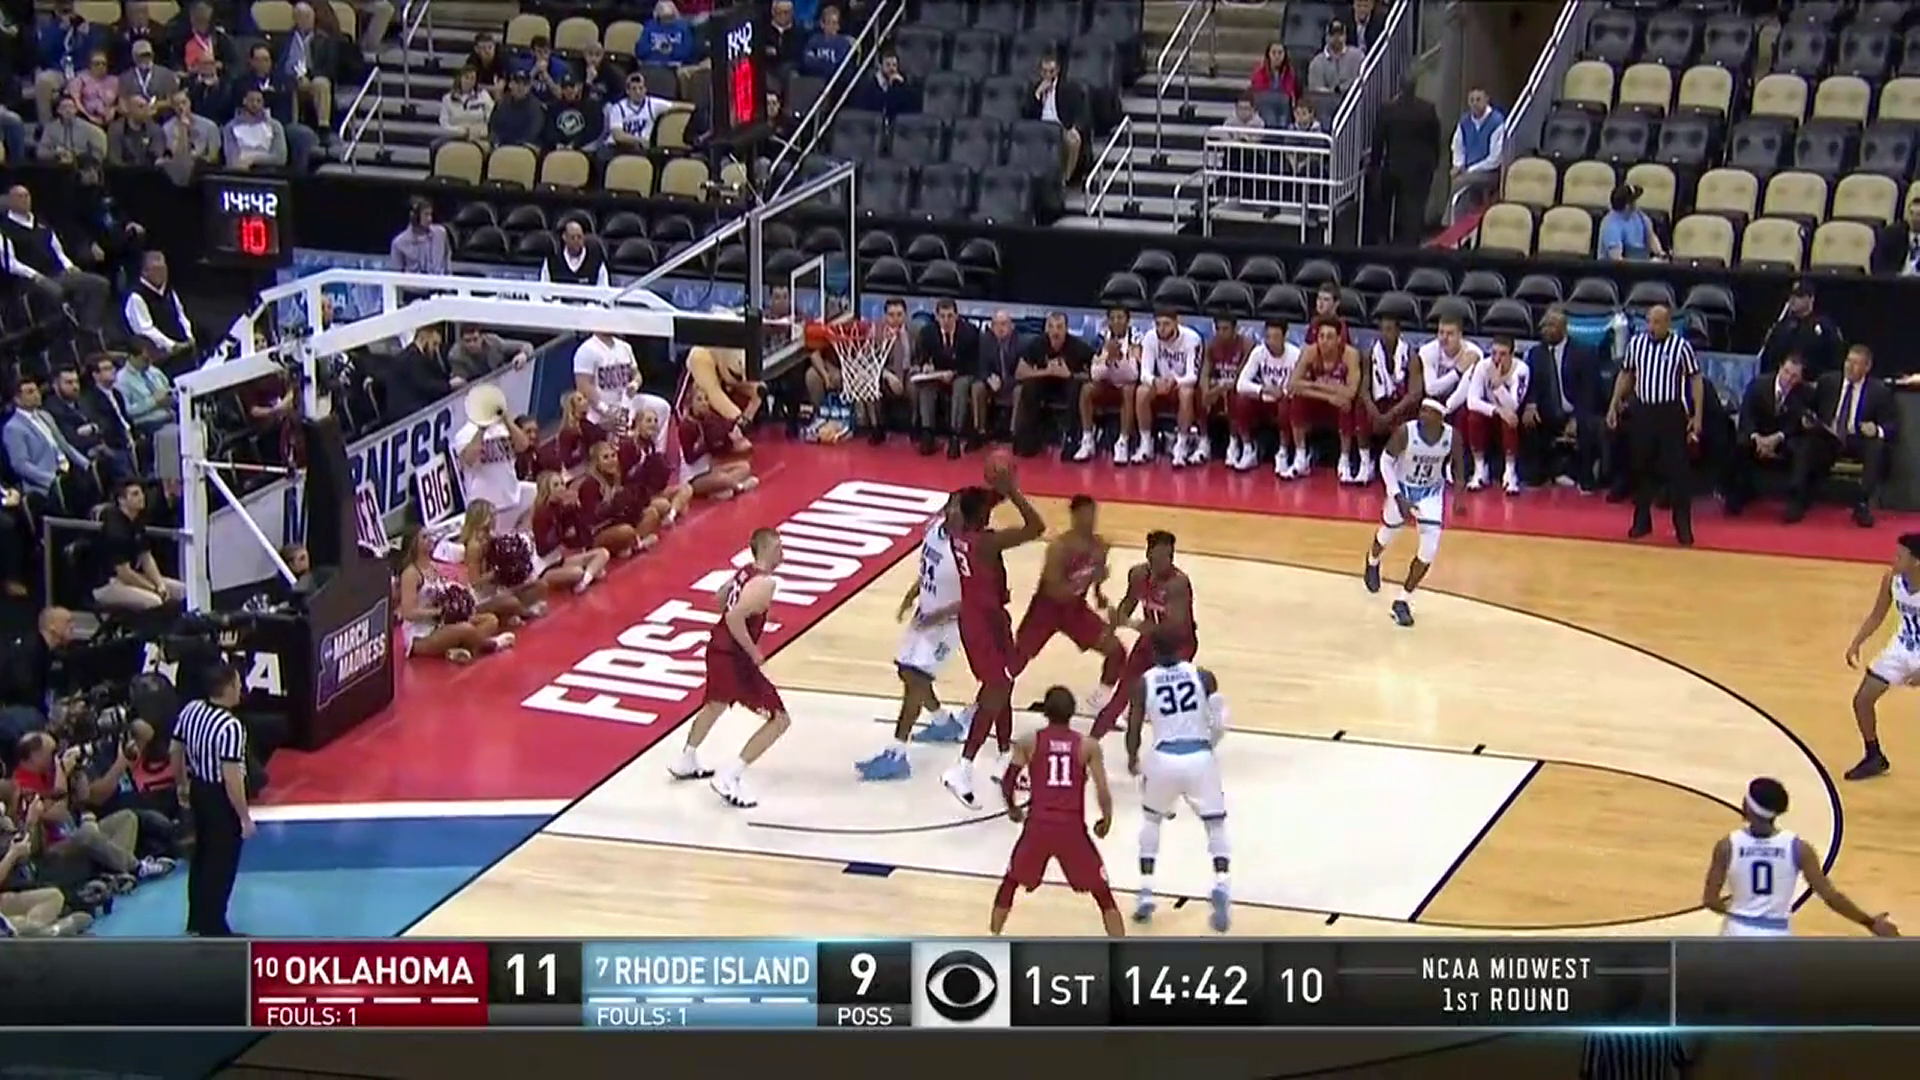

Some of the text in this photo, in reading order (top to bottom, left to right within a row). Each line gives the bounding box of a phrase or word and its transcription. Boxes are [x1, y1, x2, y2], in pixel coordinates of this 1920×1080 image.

[223, 190, 279, 217] 14:42
[242, 216, 266, 256] 10
[420, 463, 451, 521] BIG
[521, 479, 952, 726] FIRST ROUND
[333, 616, 370, 661] MARCH
[338, 632, 386, 683] MADNESS
[1155, 680, 1198, 716] 32
[1047, 754, 1072, 787] 11
[1751, 860, 1773, 896] 0
